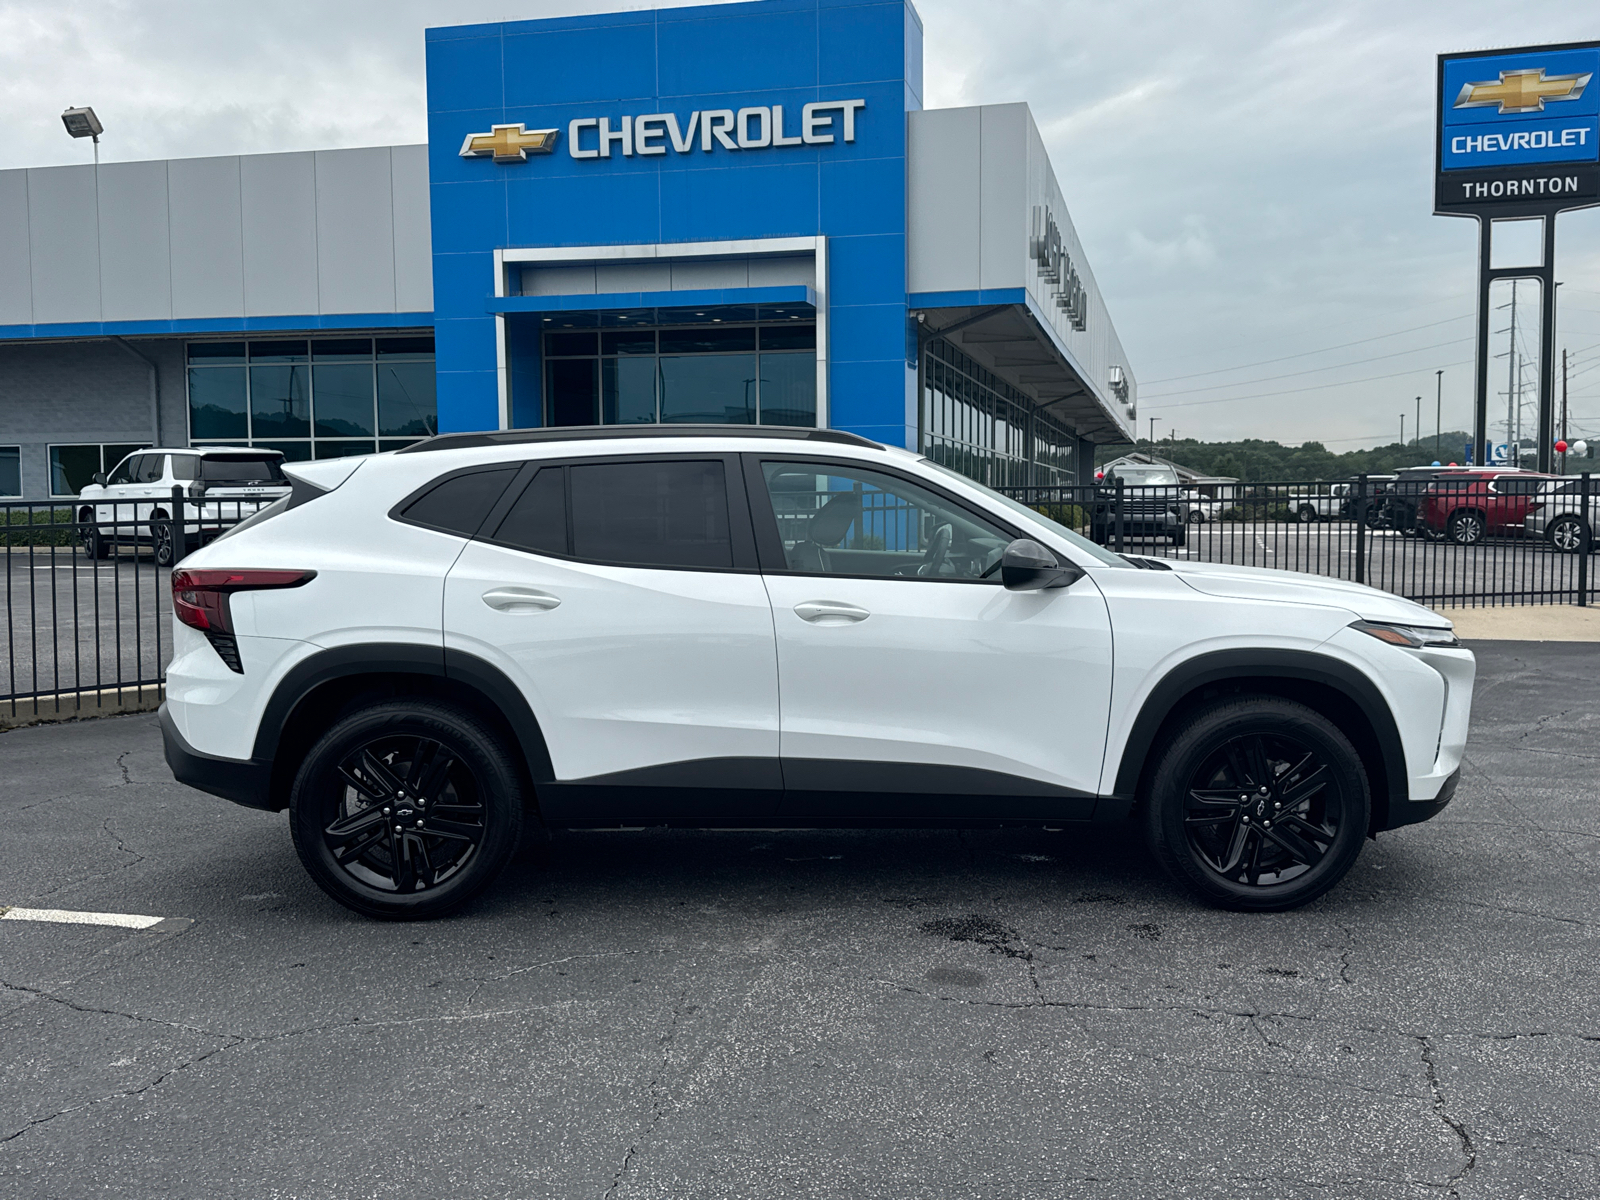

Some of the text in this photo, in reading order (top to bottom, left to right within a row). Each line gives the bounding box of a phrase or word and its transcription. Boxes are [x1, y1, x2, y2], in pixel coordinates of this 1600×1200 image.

[568, 98, 866, 159] CHEVROLET
[1451, 127, 1591, 154] CHEVROLET
[1462, 176, 1578, 198] THORNTON
